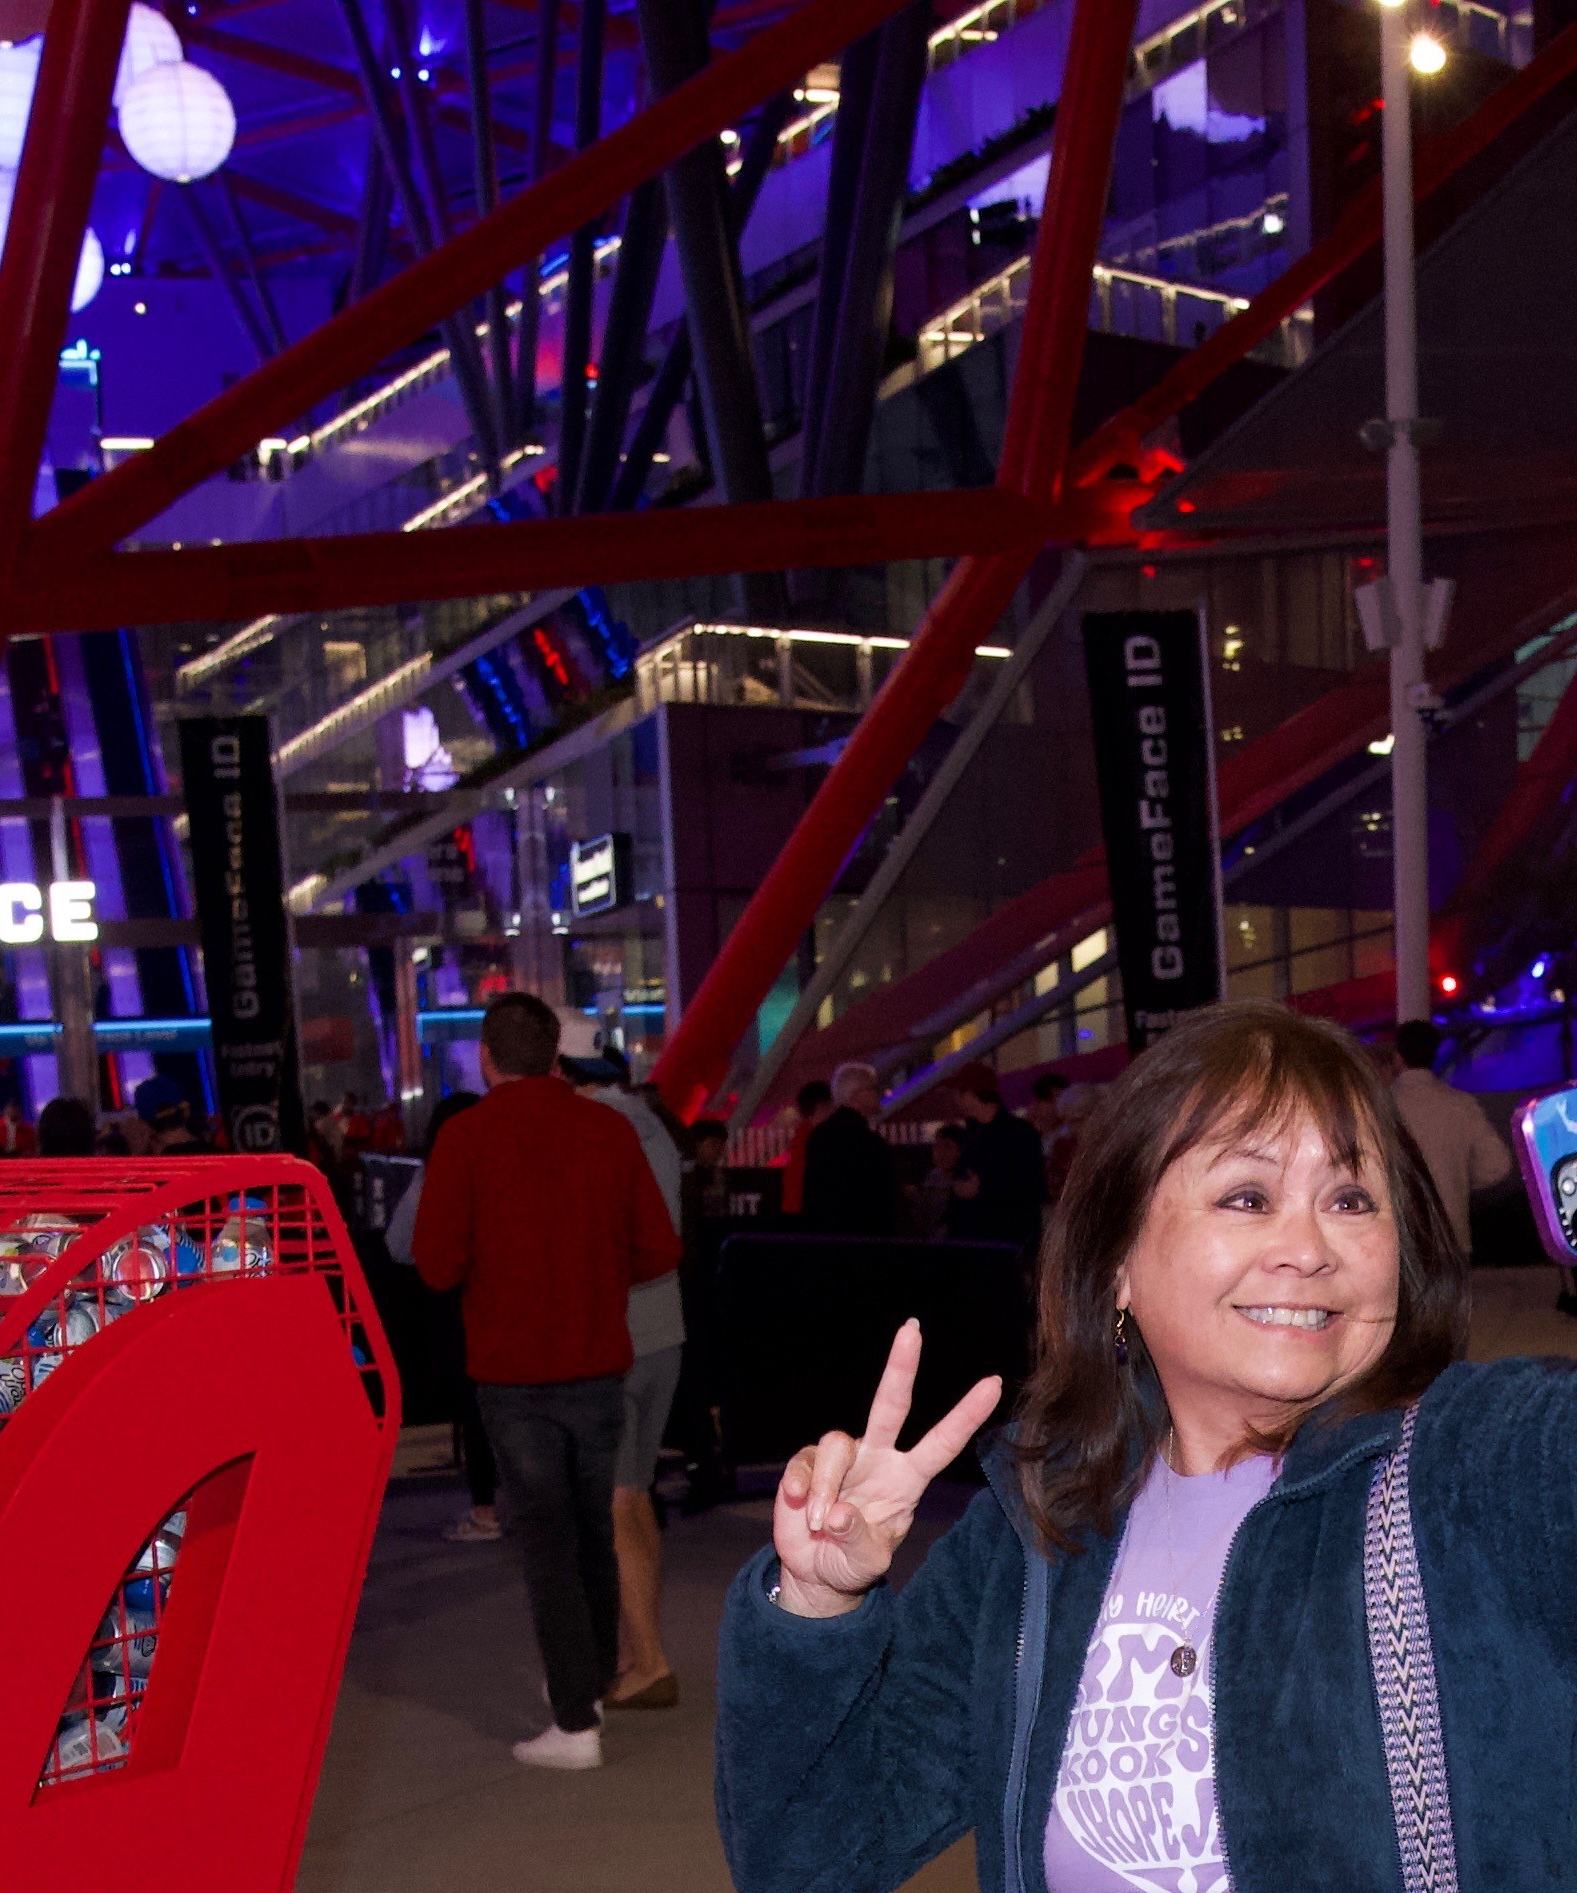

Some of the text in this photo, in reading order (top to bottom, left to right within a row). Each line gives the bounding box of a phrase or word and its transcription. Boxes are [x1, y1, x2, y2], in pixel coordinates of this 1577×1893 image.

[1125, 634, 1163, 687] ID
[211, 735, 241, 779] ID
[1138, 705, 1184, 979] GameFace
